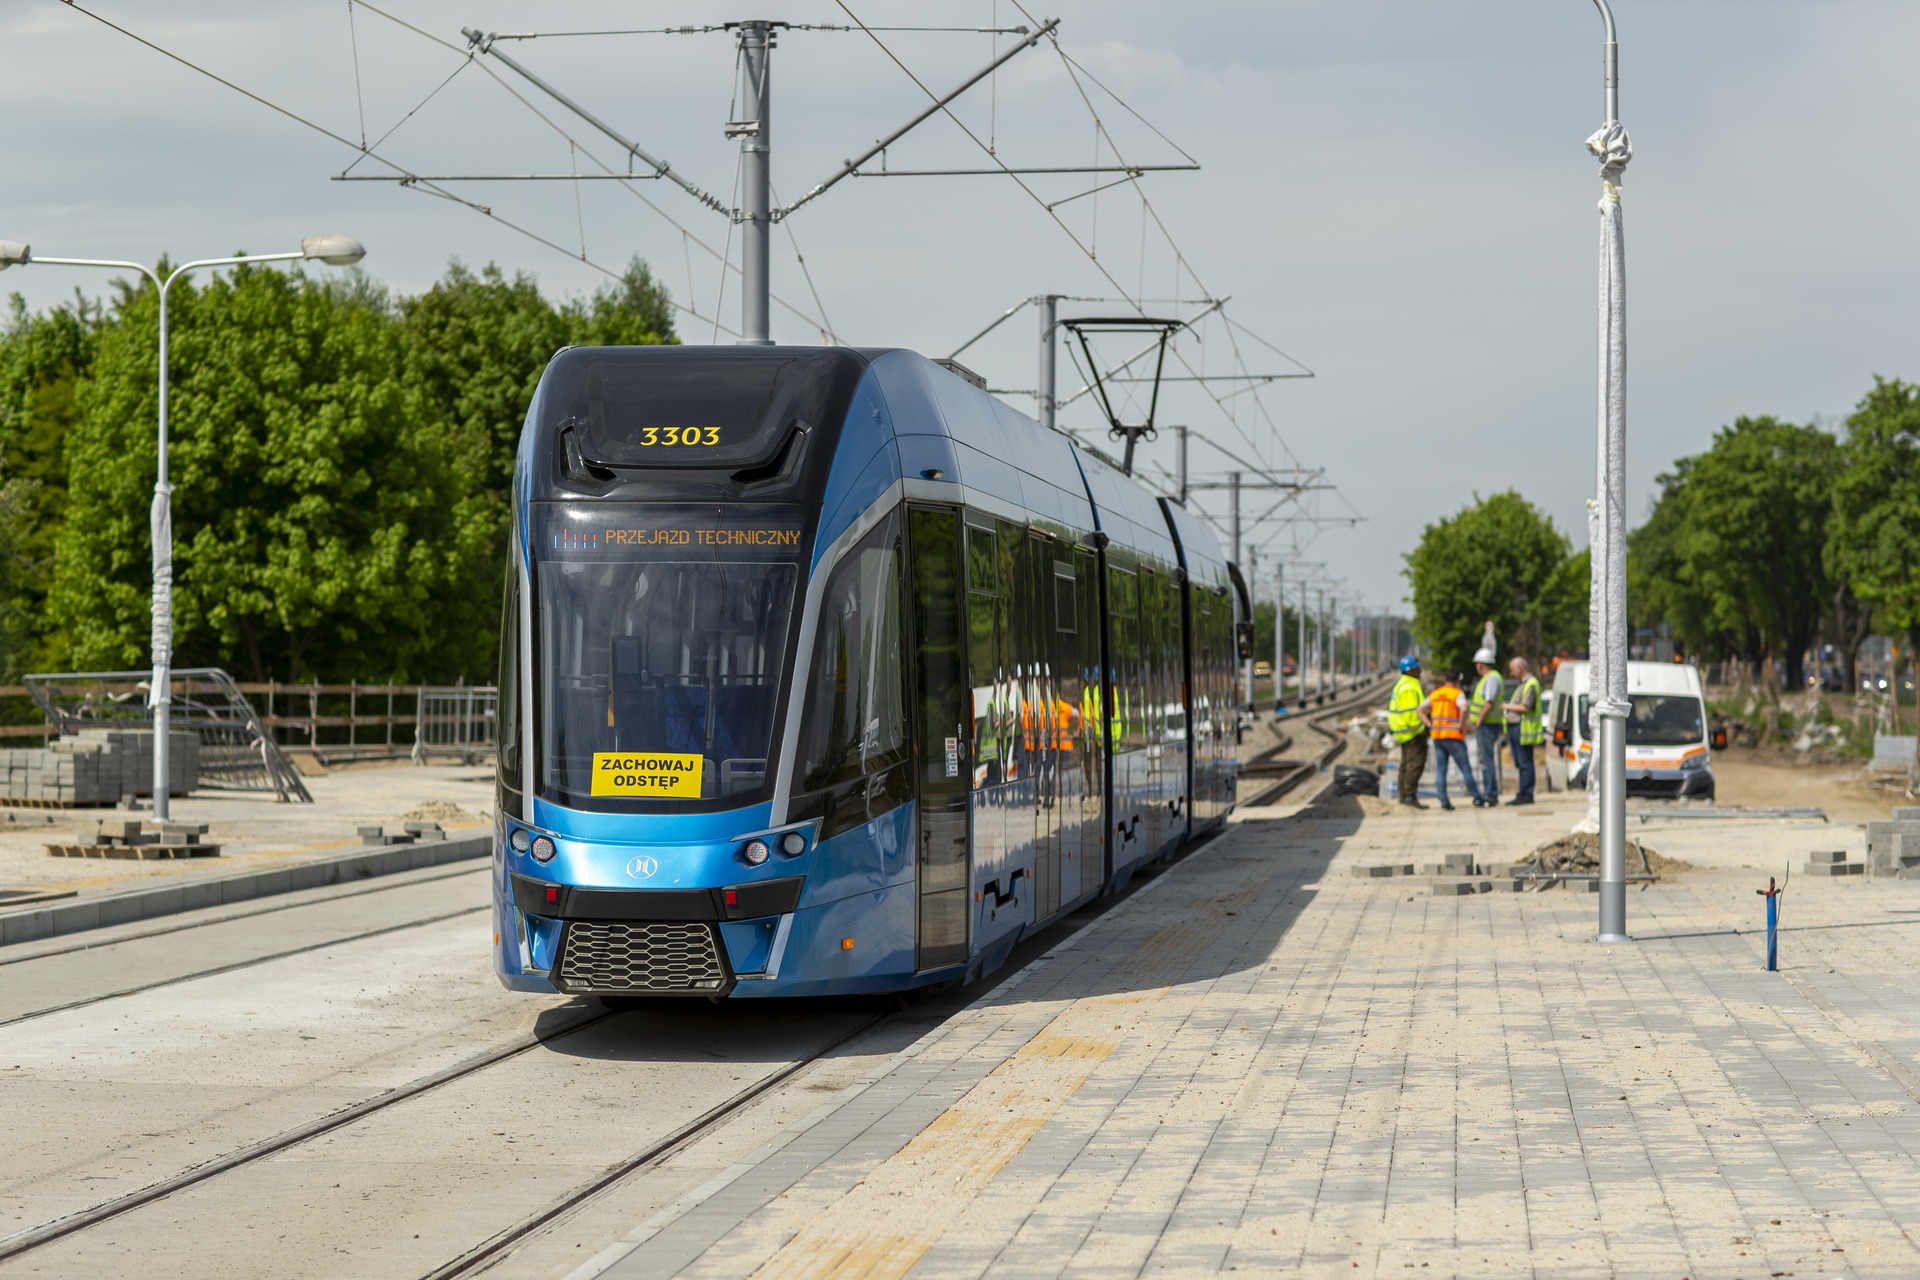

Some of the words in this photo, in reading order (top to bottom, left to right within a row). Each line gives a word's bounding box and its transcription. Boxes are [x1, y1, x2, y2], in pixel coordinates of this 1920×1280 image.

[640, 427, 721, 446] 3303
[605, 529, 690, 545] PRZEJAZD
[695, 530, 801, 545] TECHNICZNY
[601, 759, 694, 771] ZACHOWAJ
[613, 775, 680, 790] ODSTĘP
